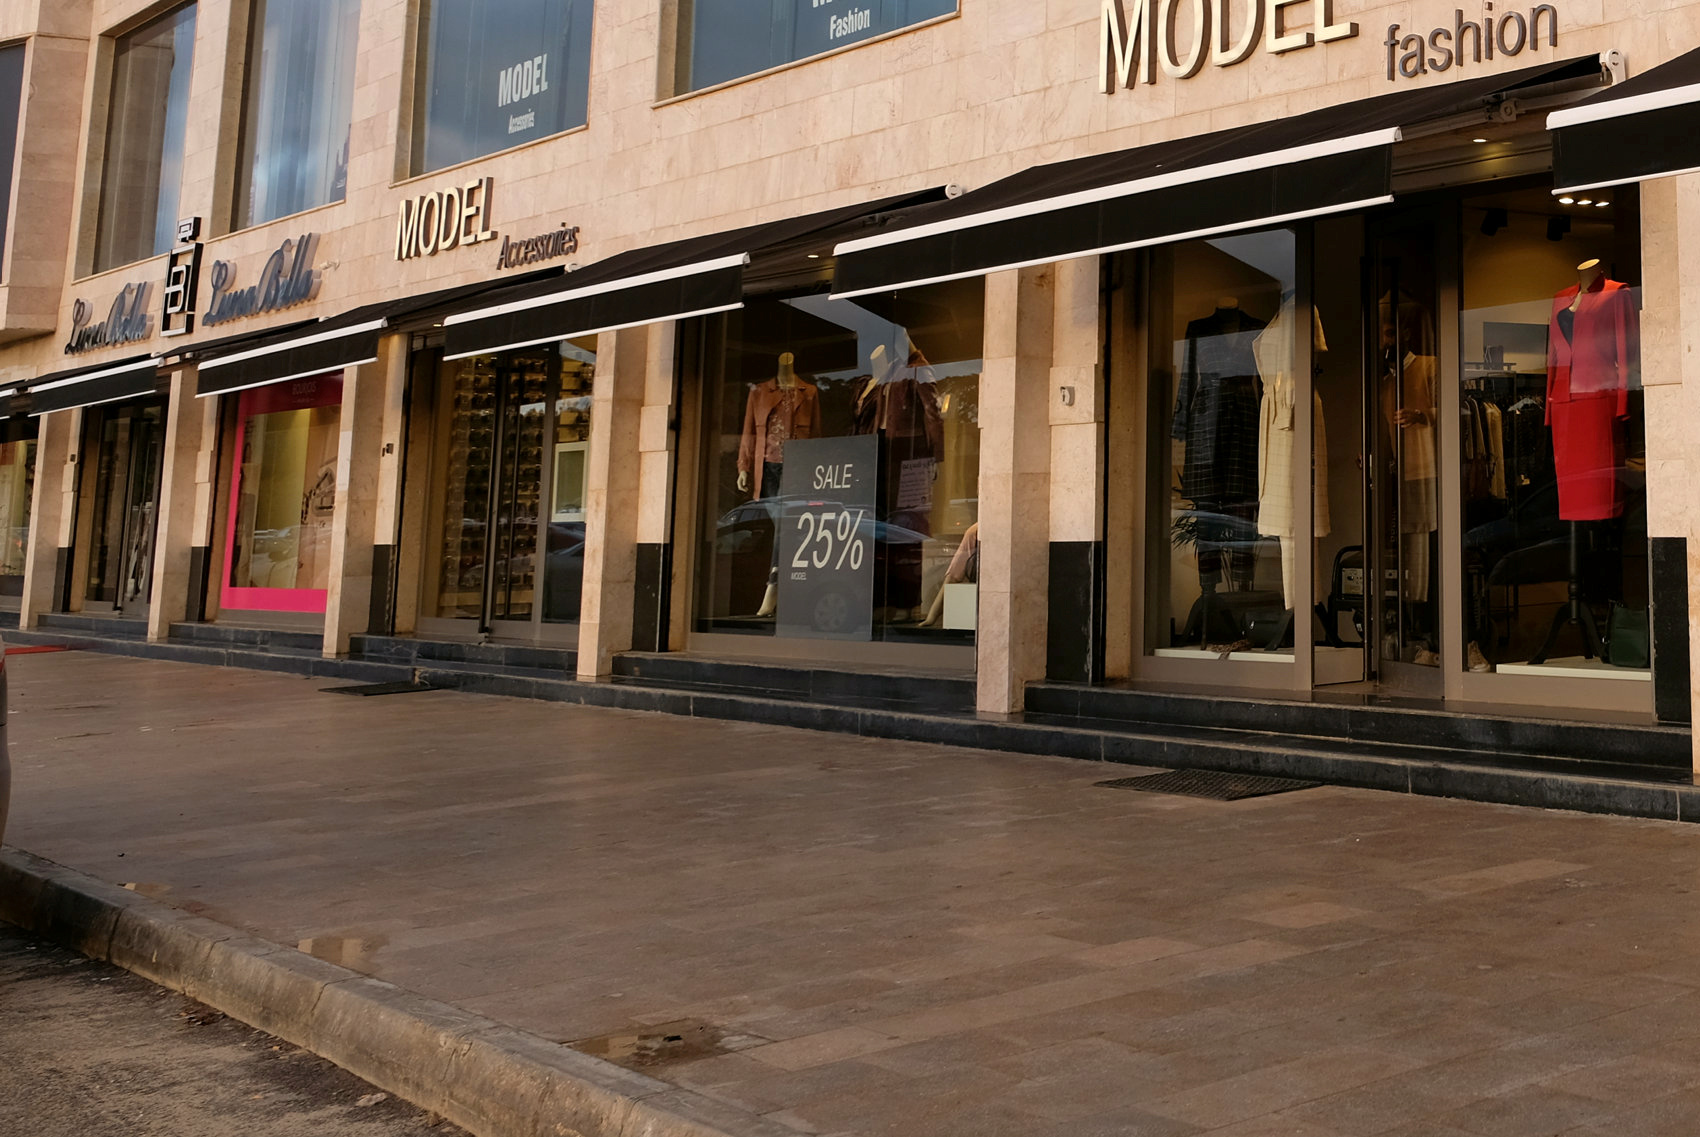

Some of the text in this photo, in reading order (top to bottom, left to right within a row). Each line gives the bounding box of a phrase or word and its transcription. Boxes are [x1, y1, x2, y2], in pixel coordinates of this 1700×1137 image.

[829, 7, 871, 40] Fashion
[1383, 1, 1558, 81] fashion
[498, 53, 549, 108] MODEL
[395, 176, 580, 271] MODEL Accessories
[812, 463, 854, 490] SALE
[791, 509, 864, 570] 25%
